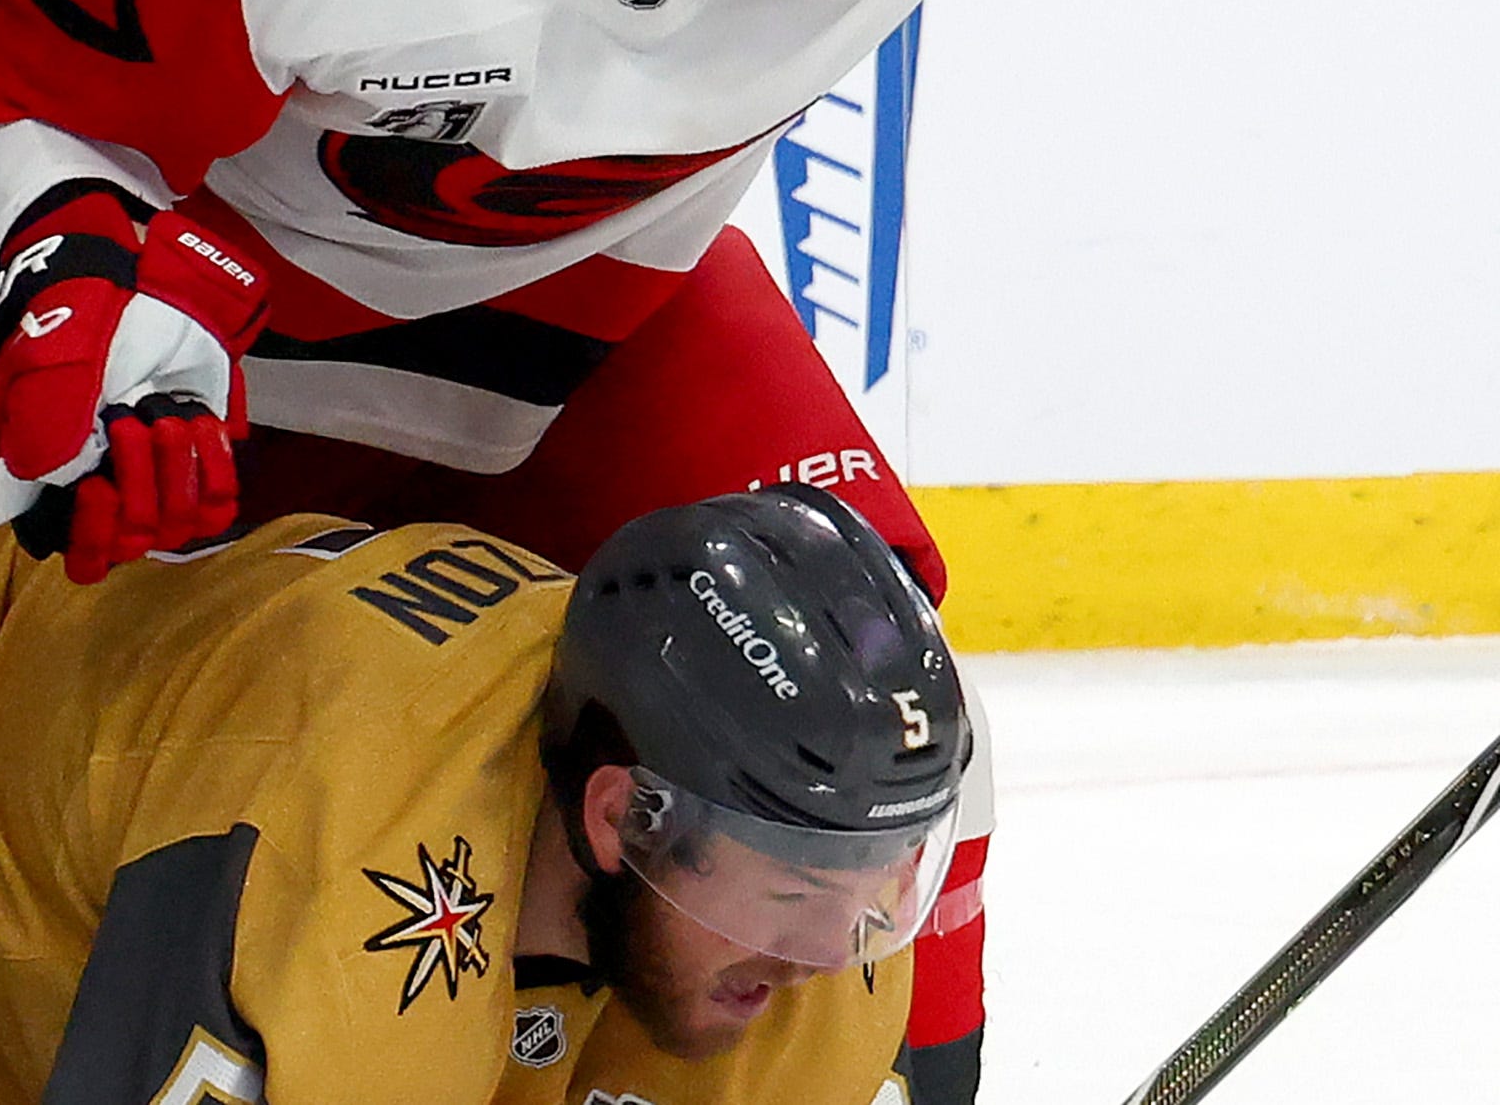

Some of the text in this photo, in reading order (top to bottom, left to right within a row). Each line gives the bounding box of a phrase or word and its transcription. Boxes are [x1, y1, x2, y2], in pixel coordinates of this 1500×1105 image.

[360, 68, 511, 91] NUCOR
[177, 232, 256, 286] BAUER
[689, 570, 799, 700] CreditOne
[891, 690, 929, 750] 5
